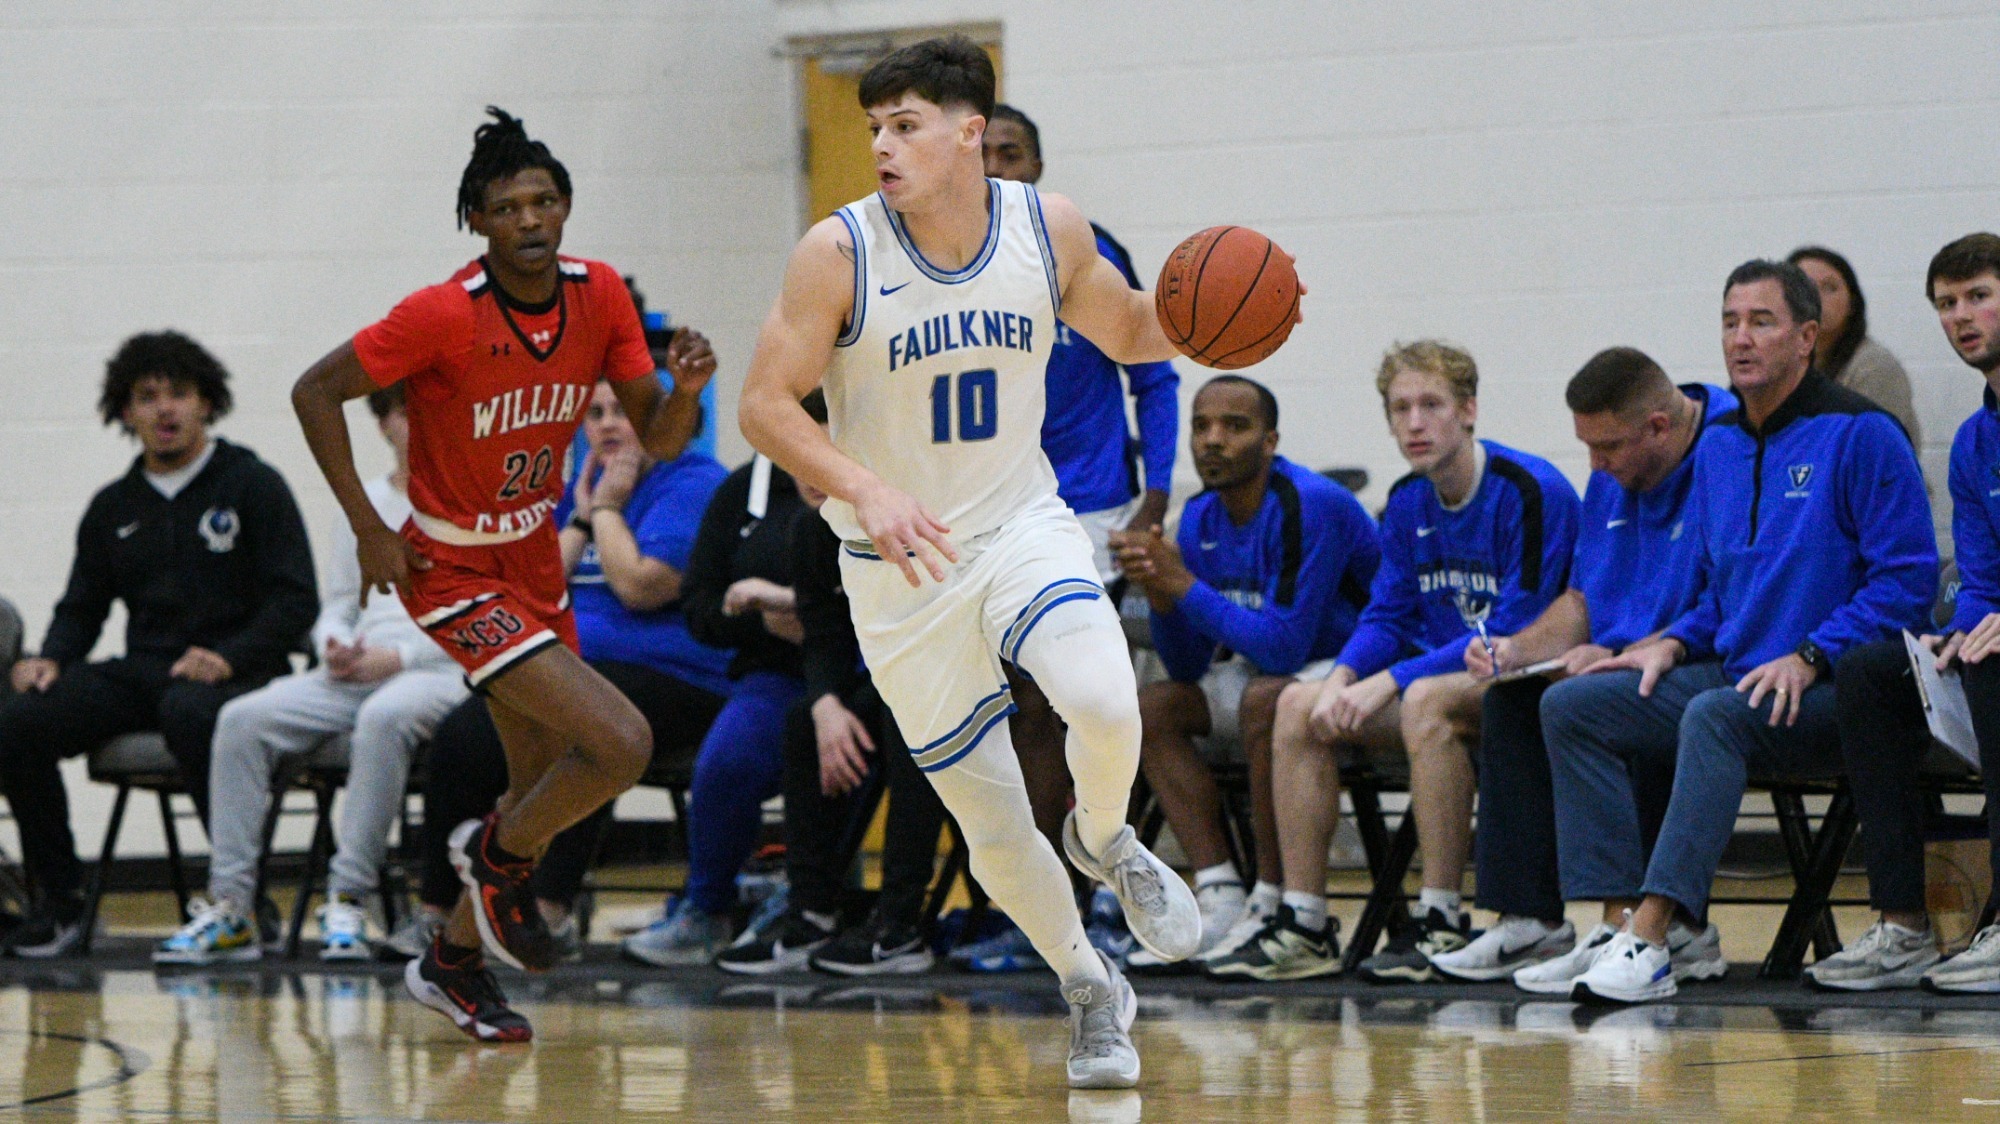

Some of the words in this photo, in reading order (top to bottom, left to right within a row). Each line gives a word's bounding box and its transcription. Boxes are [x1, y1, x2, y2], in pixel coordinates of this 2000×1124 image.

[889, 309, 1033, 372] FAULKNER
[928, 366, 998, 444] 10
[497, 444, 552, 501] 20
